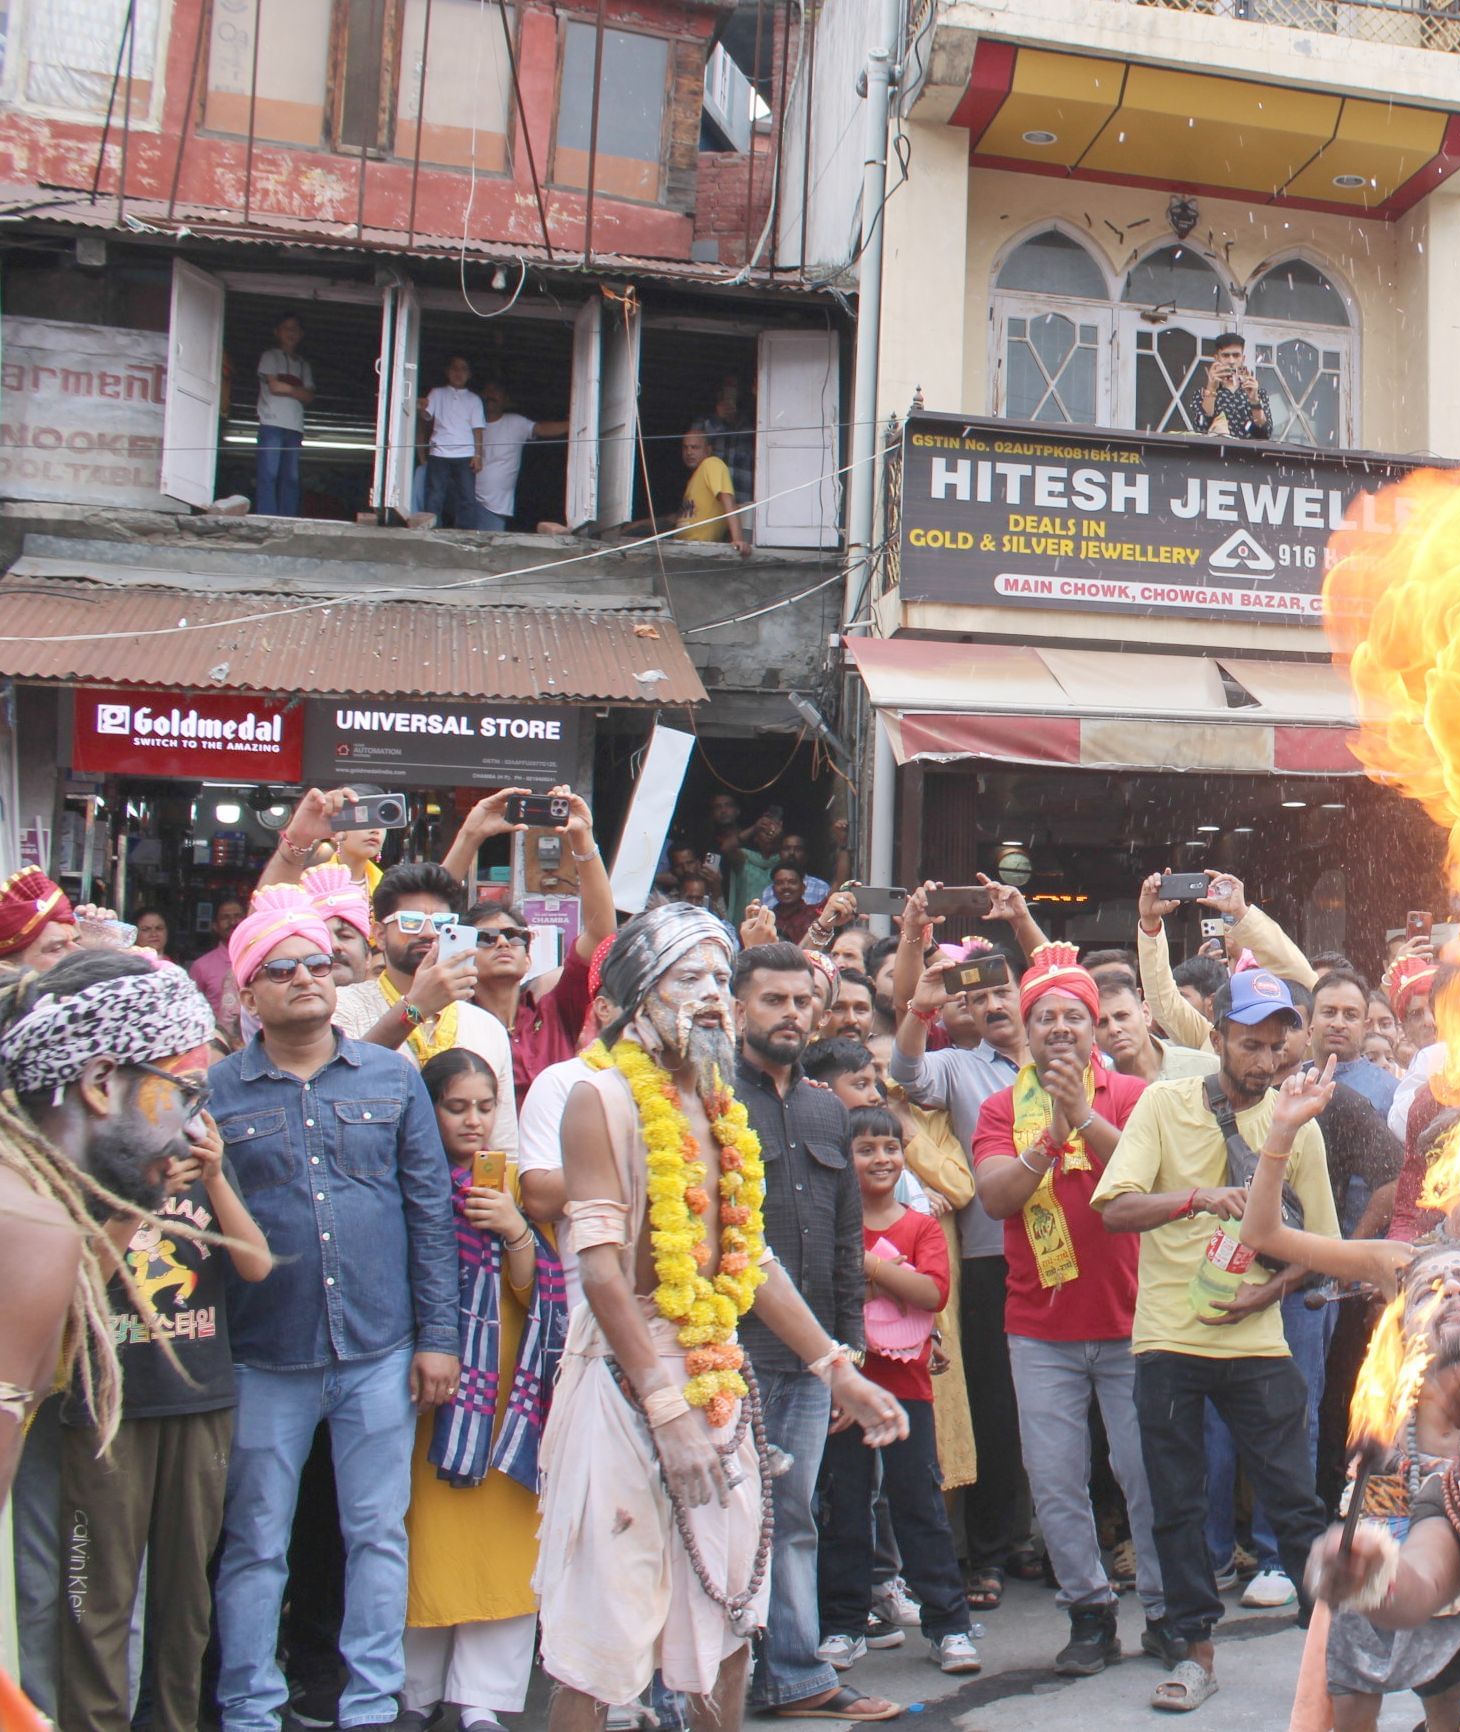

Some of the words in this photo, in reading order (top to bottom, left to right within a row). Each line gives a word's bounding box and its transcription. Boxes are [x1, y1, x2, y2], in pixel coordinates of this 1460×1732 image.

[0, 422, 164, 459] NOOKE
[912, 434, 960, 449] GSTIN
[965, 435, 990, 452] No.
[931, 457, 1150, 515] HITESH
[1009, 514, 1076, 536] DEALS
[1082, 519, 1106, 538] IN
[909, 528, 974, 550] GOLD
[980, 533, 996, 552] &
[1002, 535, 1074, 557] SILVER
[1080, 541, 1200, 565] JEWELLERY
[1279, 544, 1316, 568] 916
[1004, 578, 1053, 594] MAIN
[1060, 581, 1136, 602] CHOWK,
[1140, 587, 1233, 606] CHOWGAN
[1240, 594, 1305, 613] BAZAR,
[133, 707, 282, 742] Goldmedal
[336, 710, 475, 736] UNIVERSAL
[480, 717, 561, 740] STORE
[133, 737, 178, 748] SWITCH
[182, 739, 198, 749] TO
[202, 740, 222, 750] THE
[226, 742, 280, 753] AMAZING
